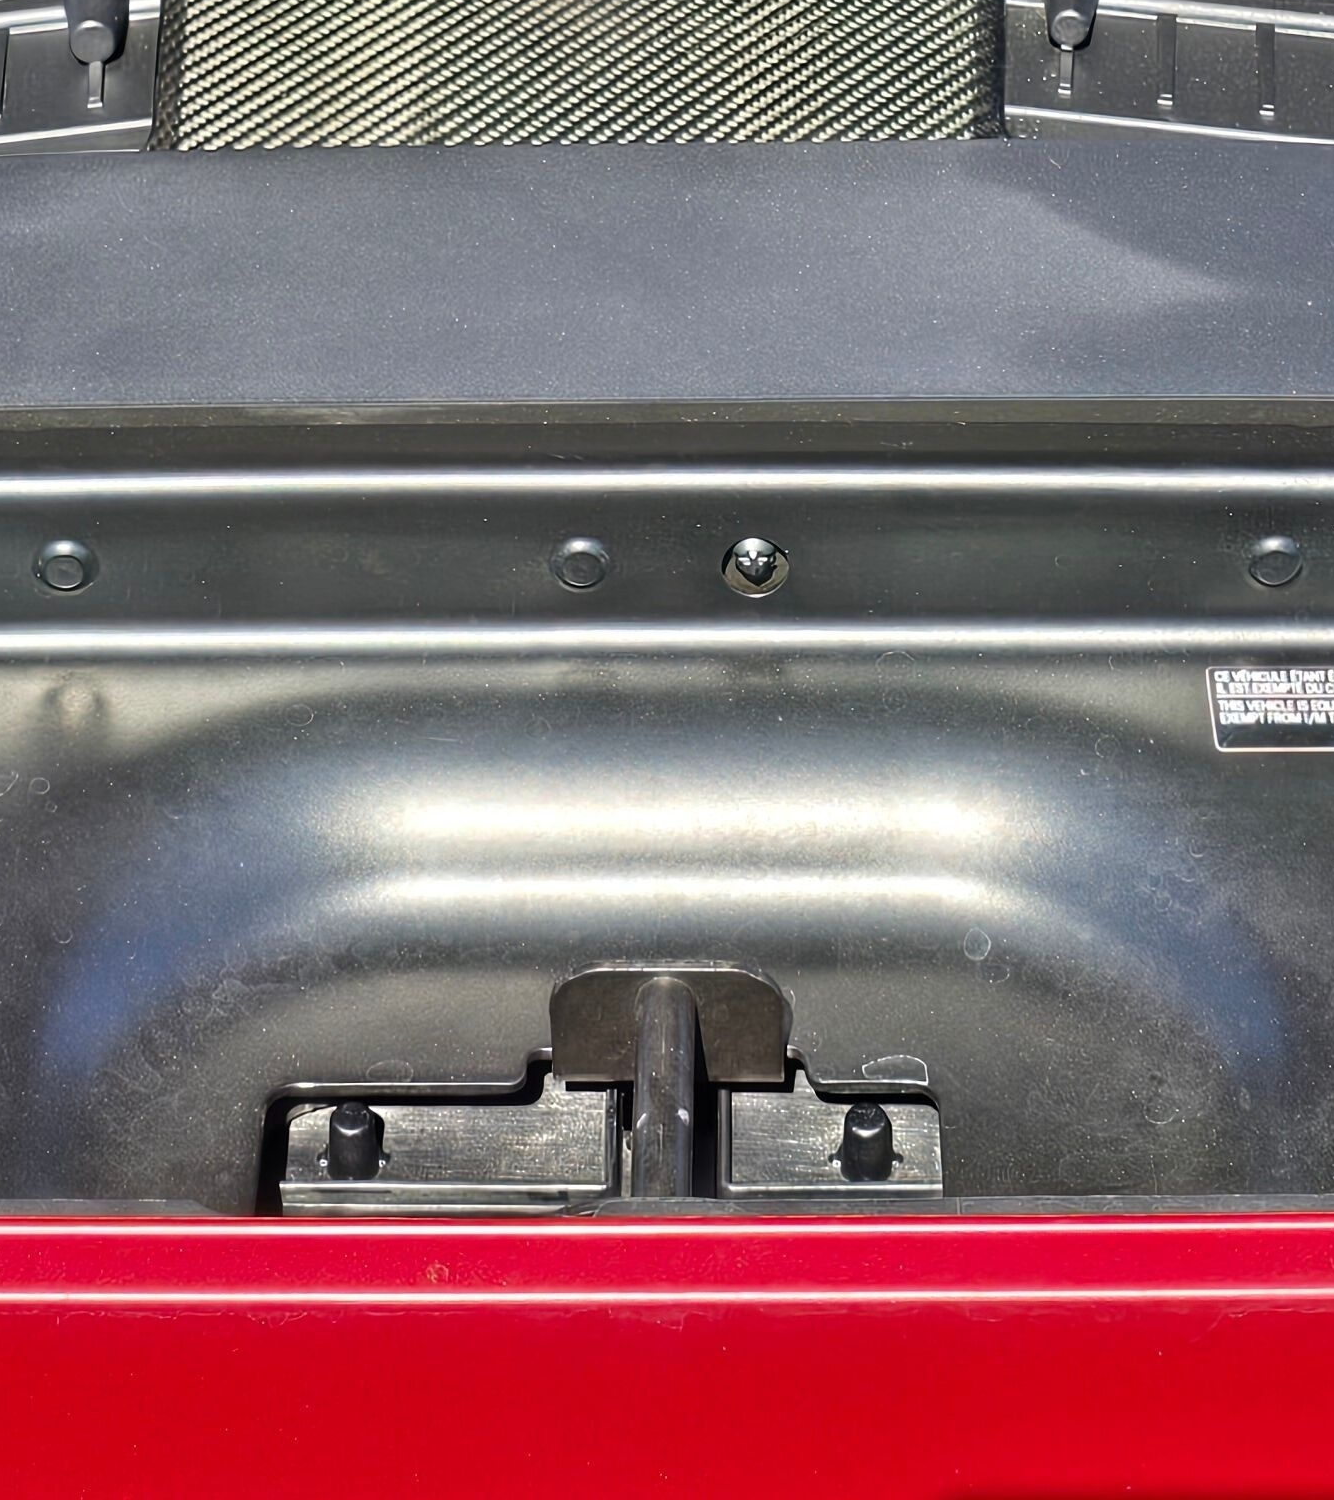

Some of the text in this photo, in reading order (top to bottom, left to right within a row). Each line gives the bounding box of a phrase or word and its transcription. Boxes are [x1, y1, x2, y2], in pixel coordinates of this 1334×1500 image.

[1218, 699, 1244, 712] THIS
[1245, 699, 1295, 712] VEHICLE
[1220, 711, 1265, 724] EXEMPT
[1267, 711, 1303, 724] FROM
